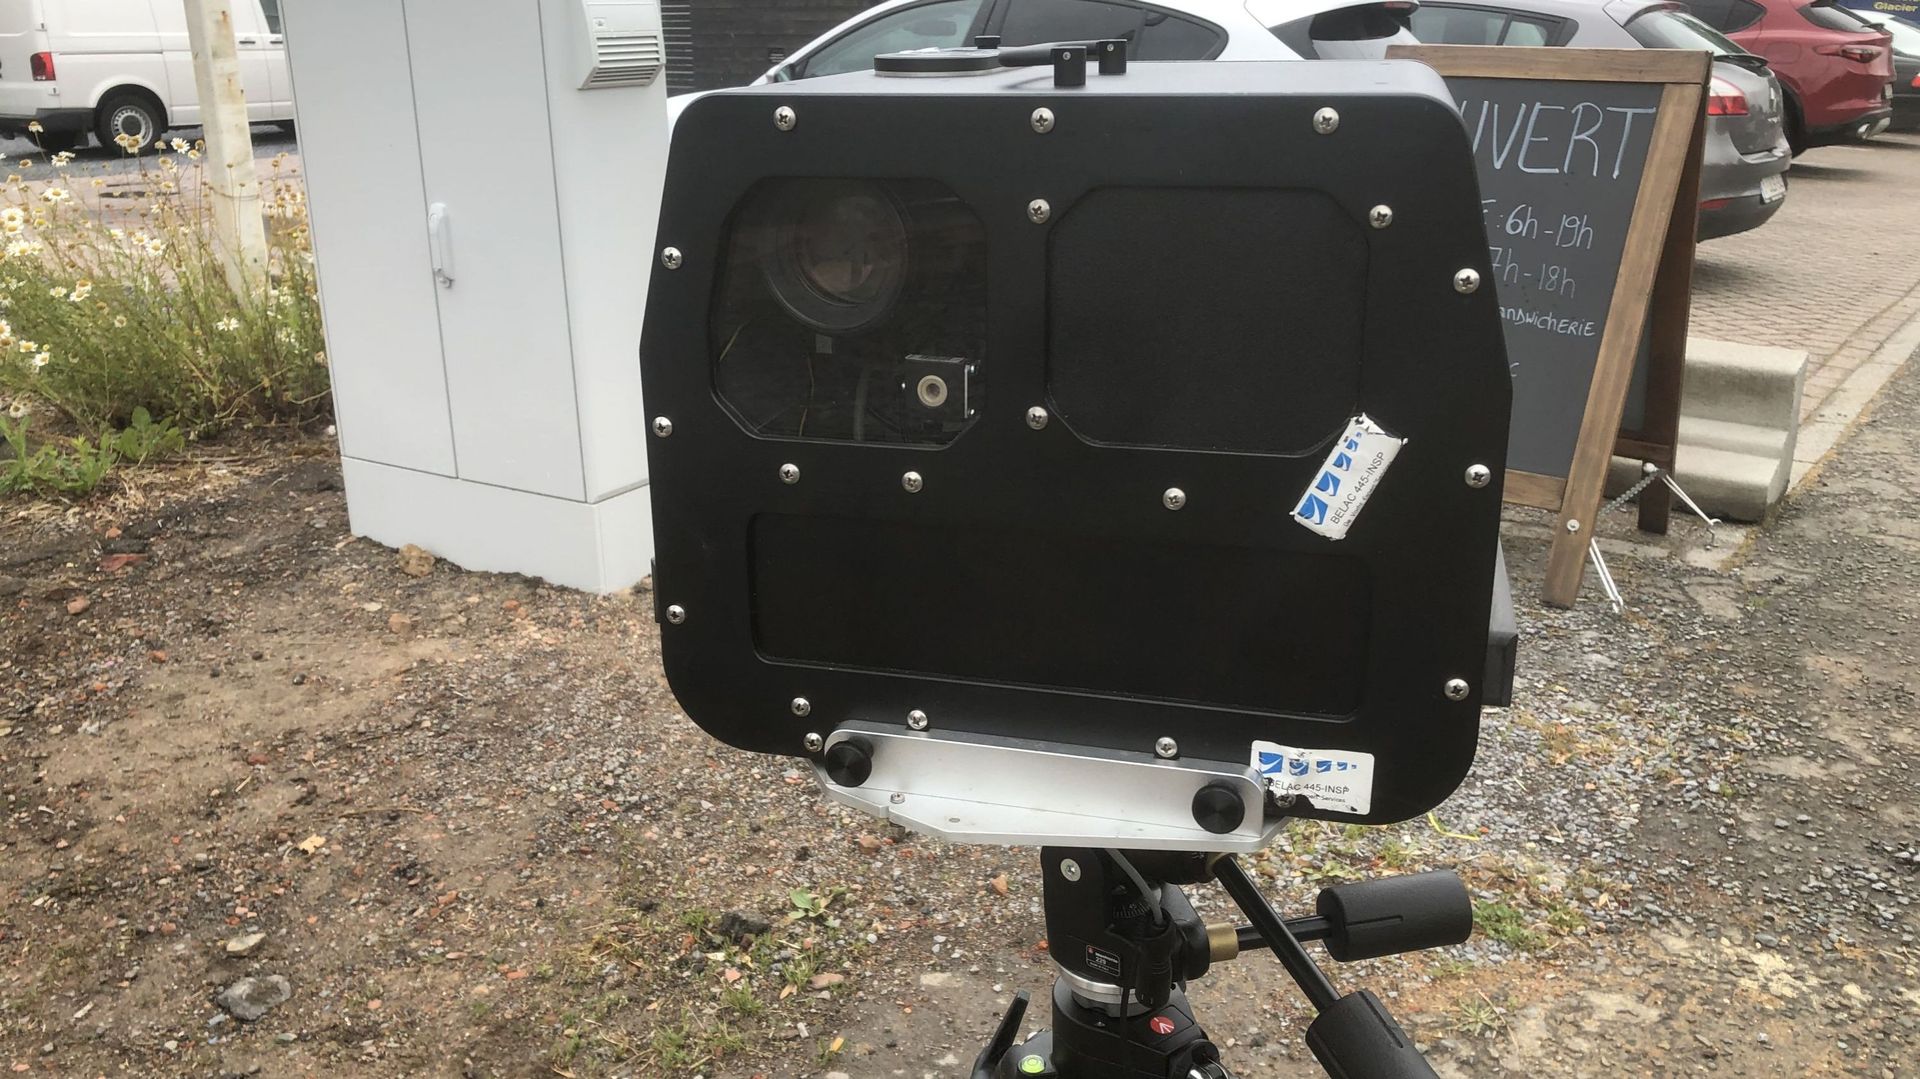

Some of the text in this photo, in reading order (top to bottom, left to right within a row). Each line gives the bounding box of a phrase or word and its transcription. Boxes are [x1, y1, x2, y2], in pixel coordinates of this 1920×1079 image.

[1873, 1, 1919, 12] Glacier
[1330, 493, 1357, 525] BELAC
[1354, 451, 1385, 493] 445-INSP
[1303, 783, 1350, 795] 445-INSP
